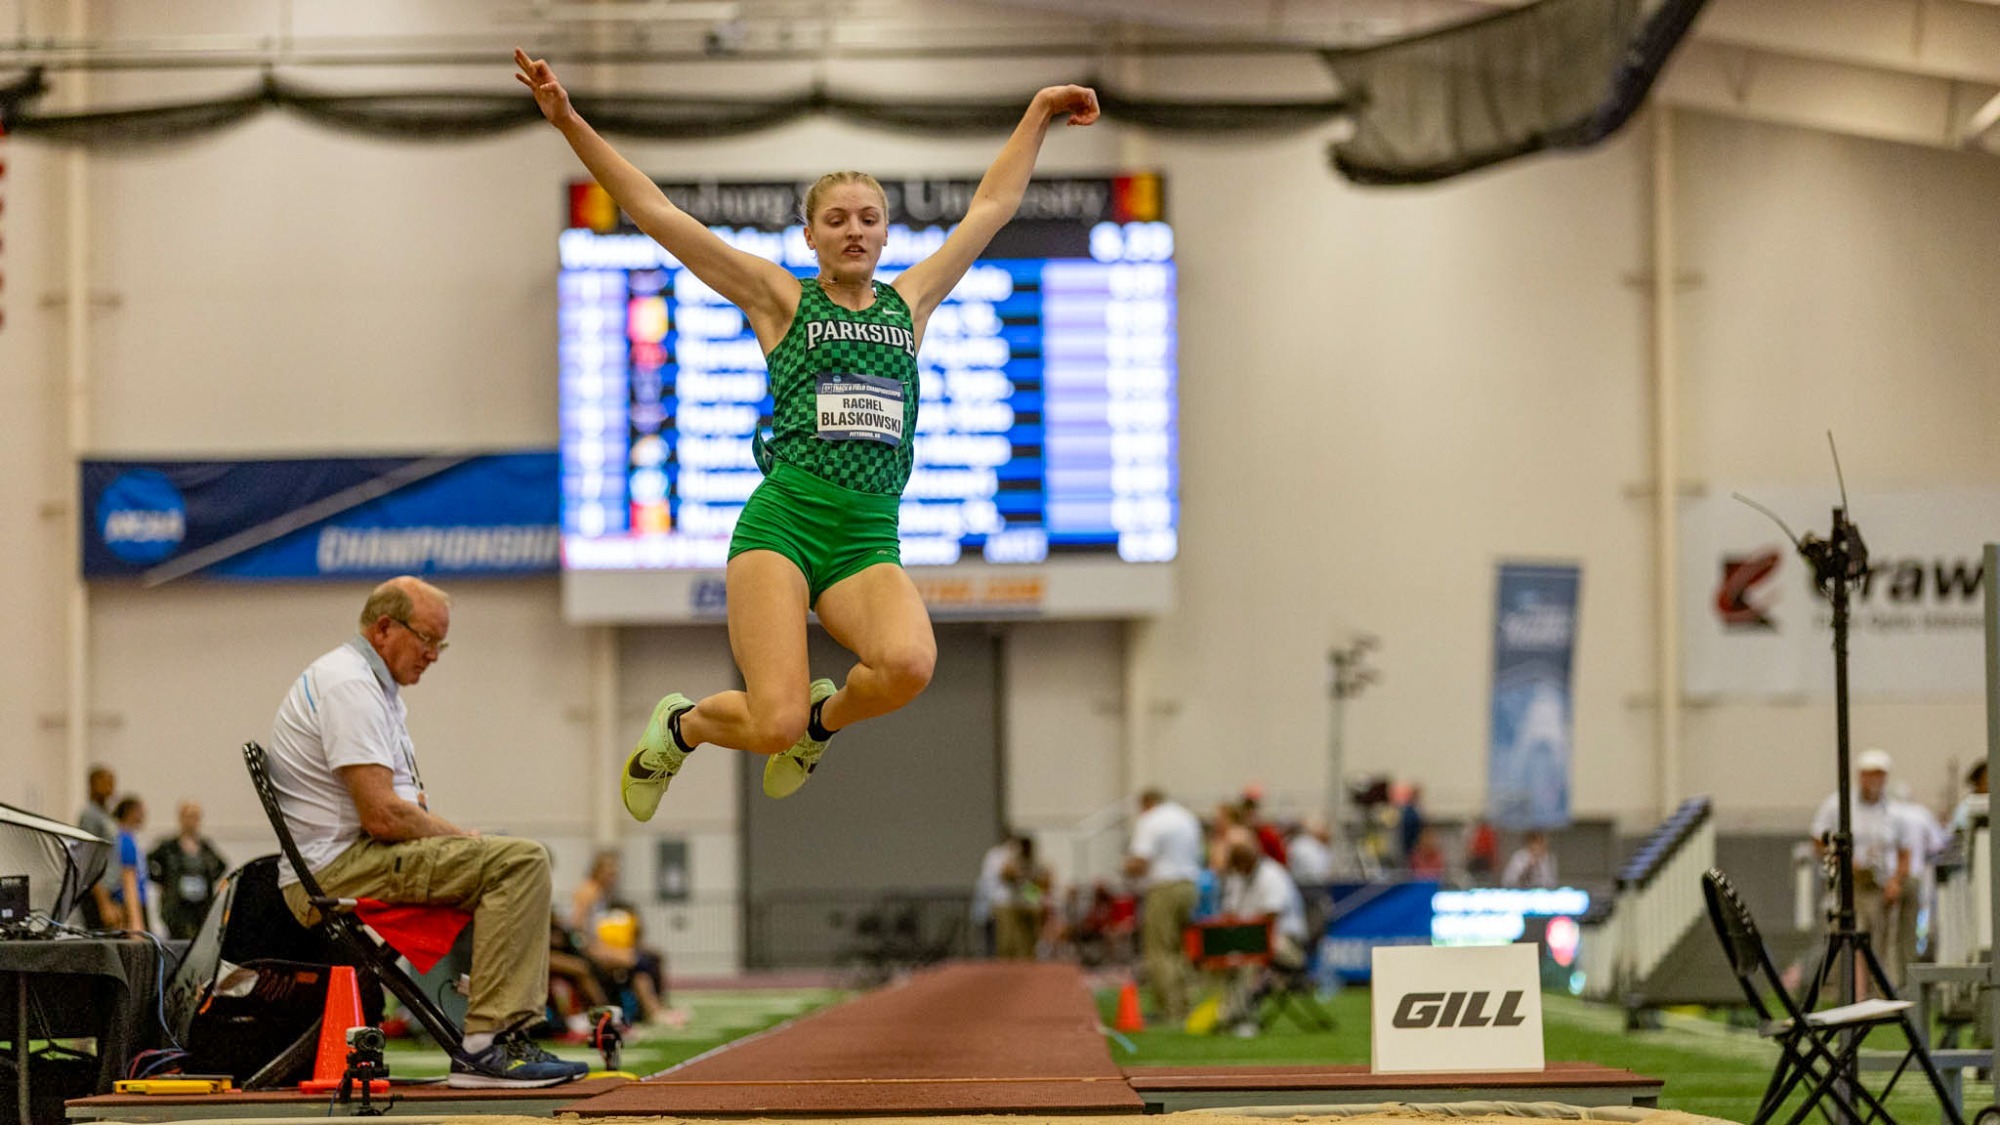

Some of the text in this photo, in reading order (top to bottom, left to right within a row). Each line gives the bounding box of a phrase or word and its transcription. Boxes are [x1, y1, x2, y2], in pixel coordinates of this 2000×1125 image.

[806, 319, 915, 358] PARKSIDE
[843, 398, 884, 412] RACHEL
[821, 412, 901, 433] BLASKOWSKI
[1392, 990, 1526, 1029] GILL
